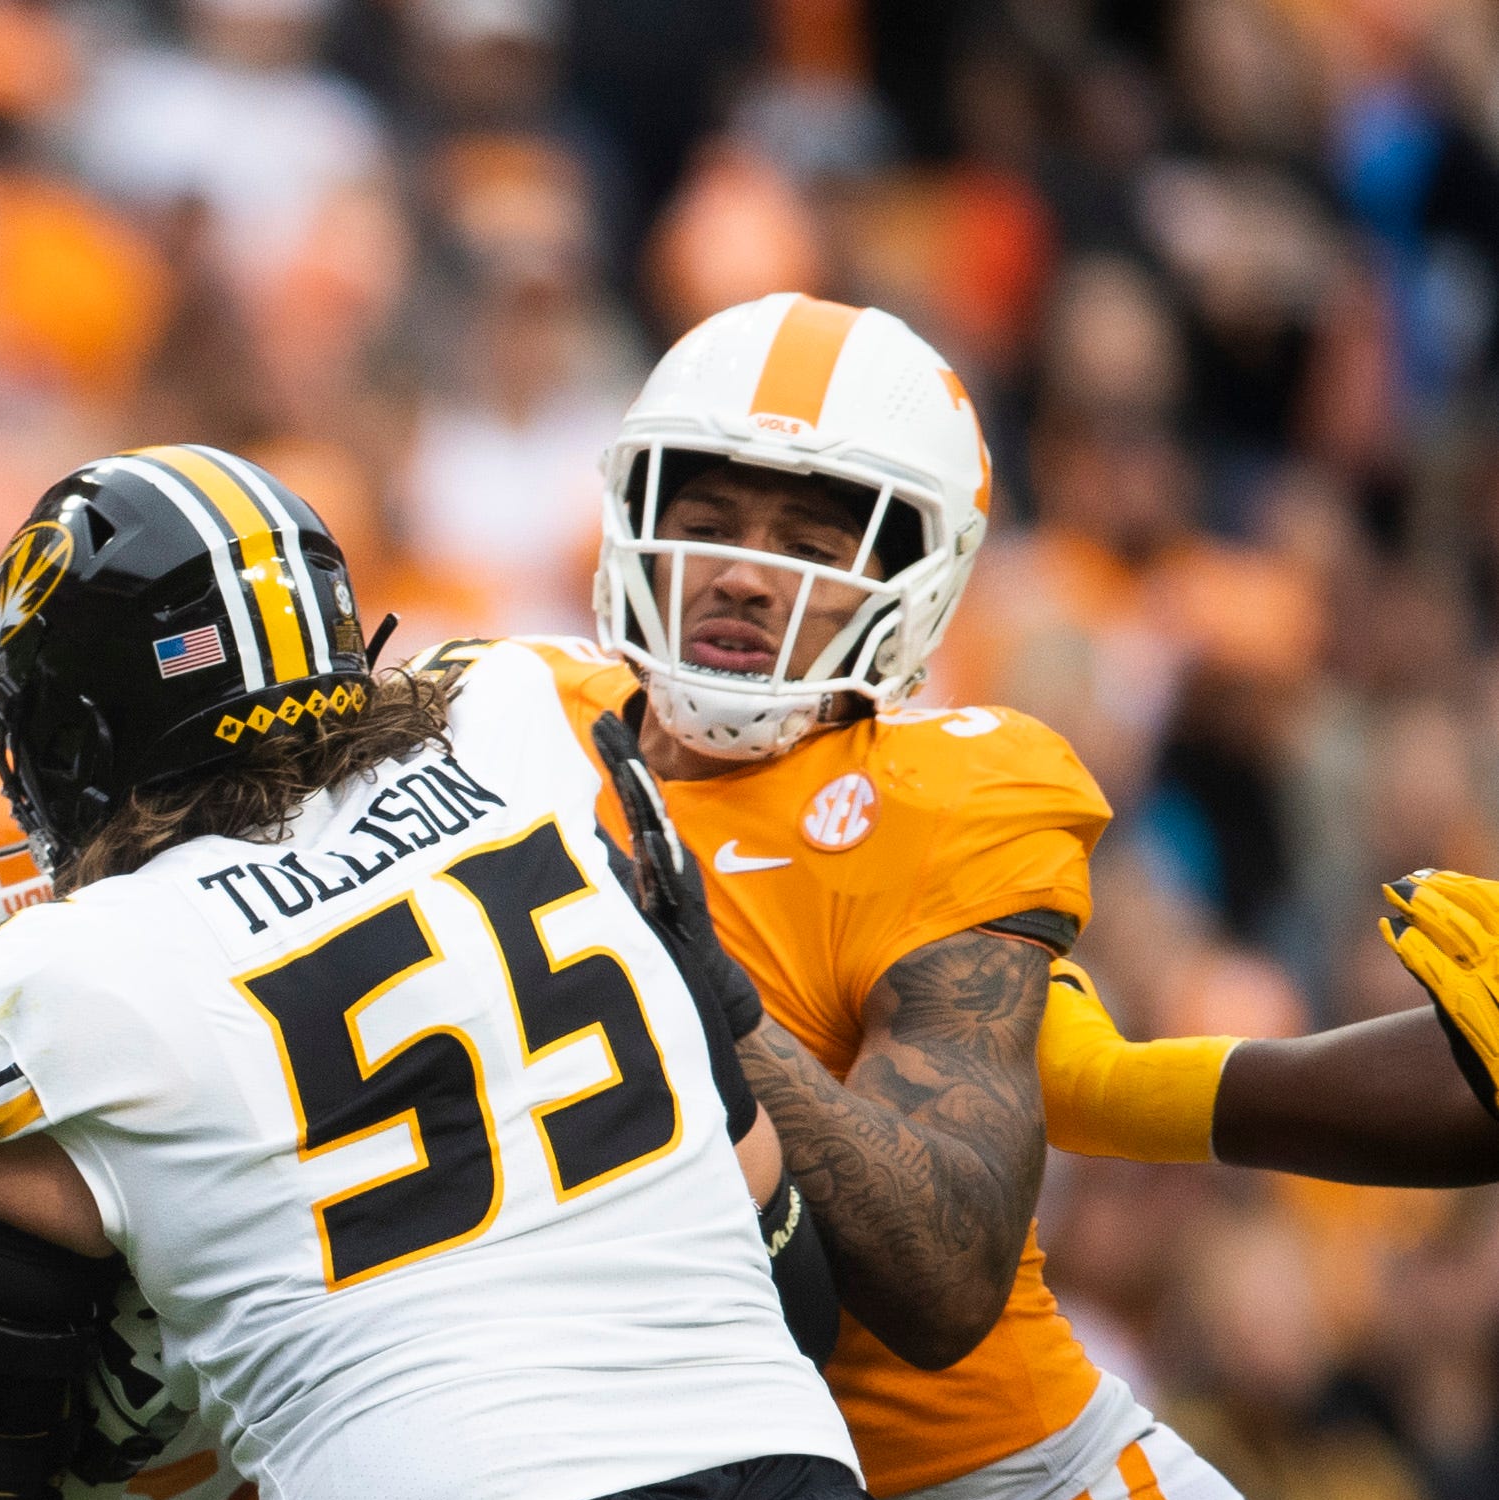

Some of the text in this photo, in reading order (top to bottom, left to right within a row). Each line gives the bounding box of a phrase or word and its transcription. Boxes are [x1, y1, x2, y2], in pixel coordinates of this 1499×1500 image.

[758, 416, 801, 435] VOLS
[197, 754, 507, 935] TOLLISON
[804, 773, 876, 847] SEC
[229, 811, 684, 1294] 55
